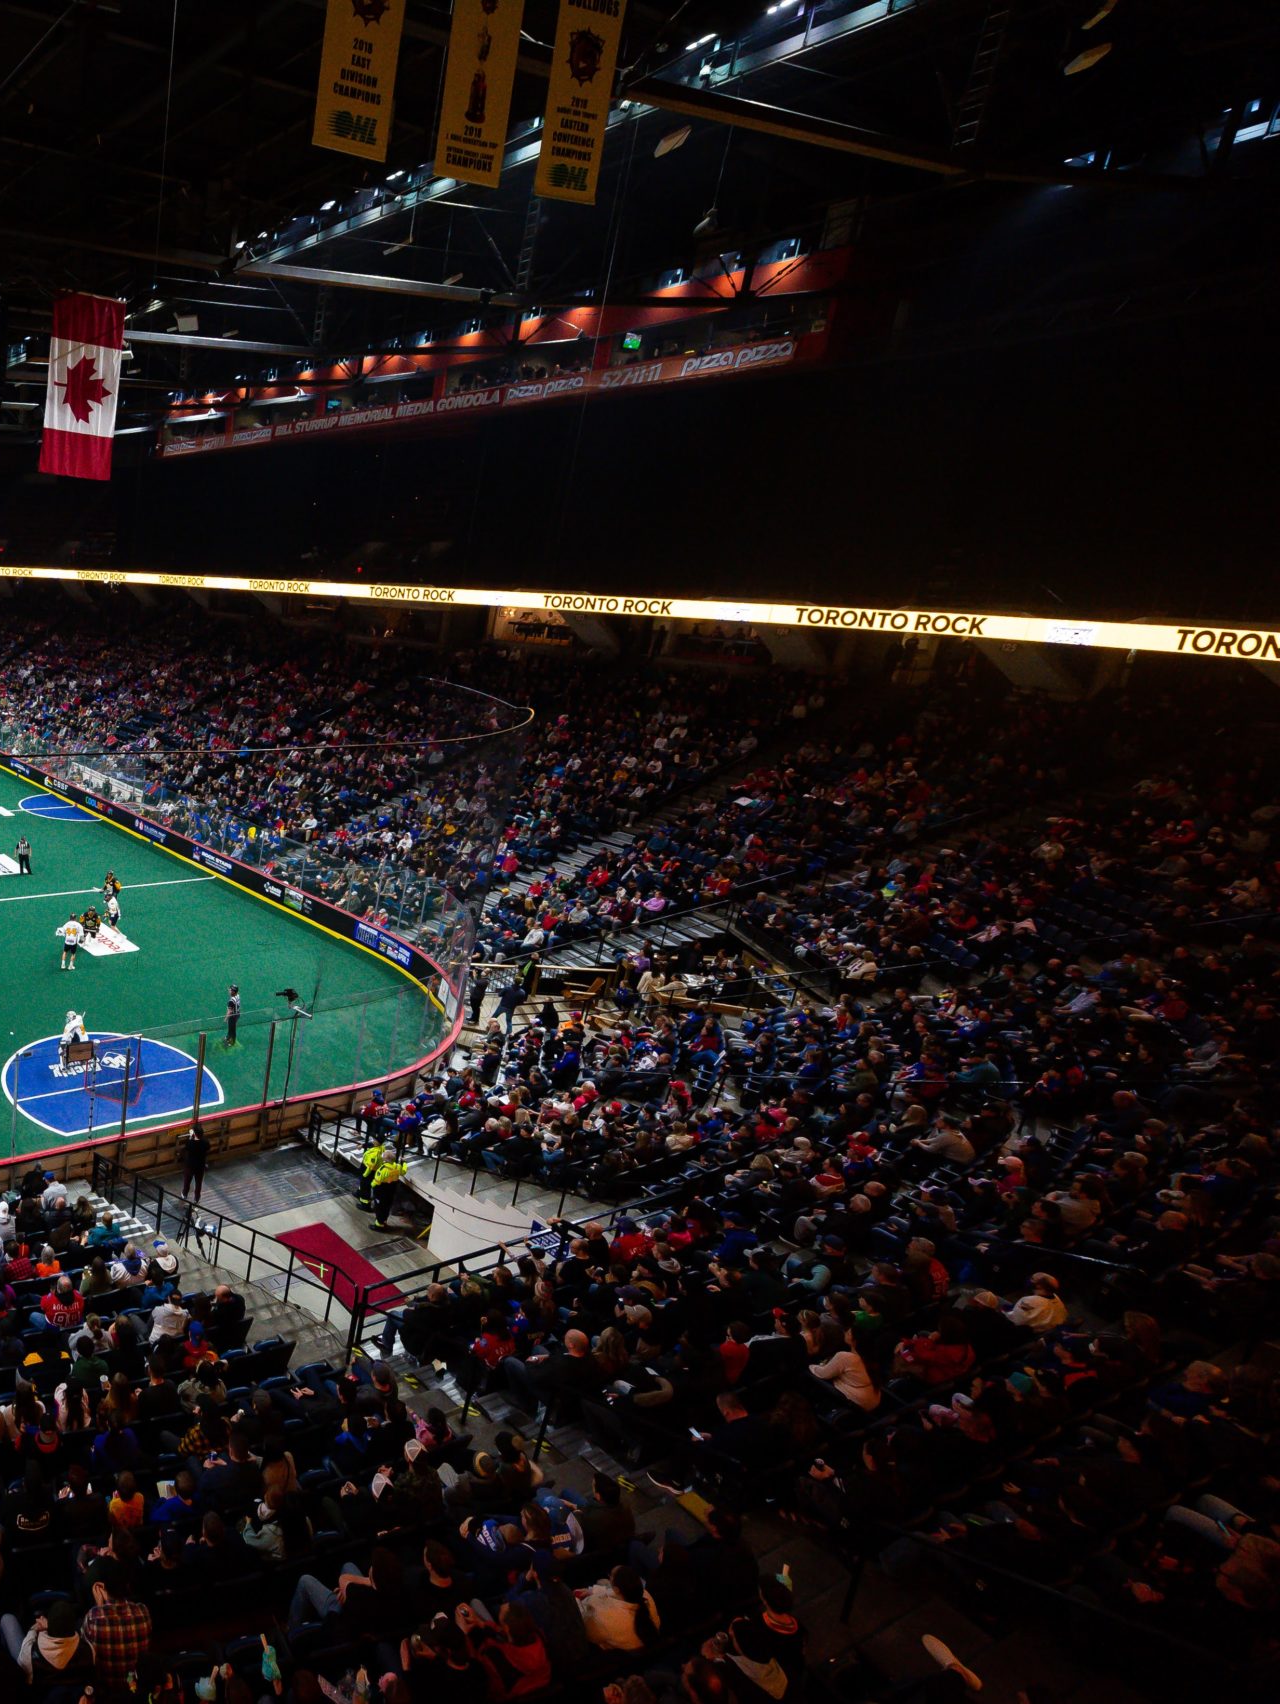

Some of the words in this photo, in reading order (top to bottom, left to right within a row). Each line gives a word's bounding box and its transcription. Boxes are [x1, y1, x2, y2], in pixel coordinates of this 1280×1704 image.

[351, 54, 372, 70] EAST
[340, 67, 378, 89] DIVISION
[332, 82, 382, 106] CHAMPIONS
[326, 110, 378, 146] OHL
[560, 118, 590, 133] EASTERN
[552, 130, 596, 149] CONFERENCE
[446, 153, 493, 173] CHAMPIONS
[551, 145, 593, 162] CHAMPIONS
[546, 162, 589, 192] OHL
[274, 424, 293, 437] BILL
[338, 408, 395, 427] MEMORIAL
[395, 400, 435, 419] MEDIA
[436, 389, 501, 412] GONDOLA
[12, 567, 33, 577] ROCK
[76, 571, 108, 581] TORONTO
[109, 573, 127, 582] ROCK
[158, 575, 186, 585] TORONTO
[187, 576, 205, 586] ROCK
[248, 579, 285, 592] TORONTO
[286, 581, 310, 593] ROCK
[369, 586, 421, 600] TORONTO
[423, 588, 455, 602] ROCK
[542, 595, 619, 612] TORONTO
[622, 597, 673, 616] ROCK
[795, 607, 910, 631] TORONTO
[913, 612, 988, 636] ROCK
[1176, 628, 1280, 660] TORON
[216, 858, 233, 870] STARS
